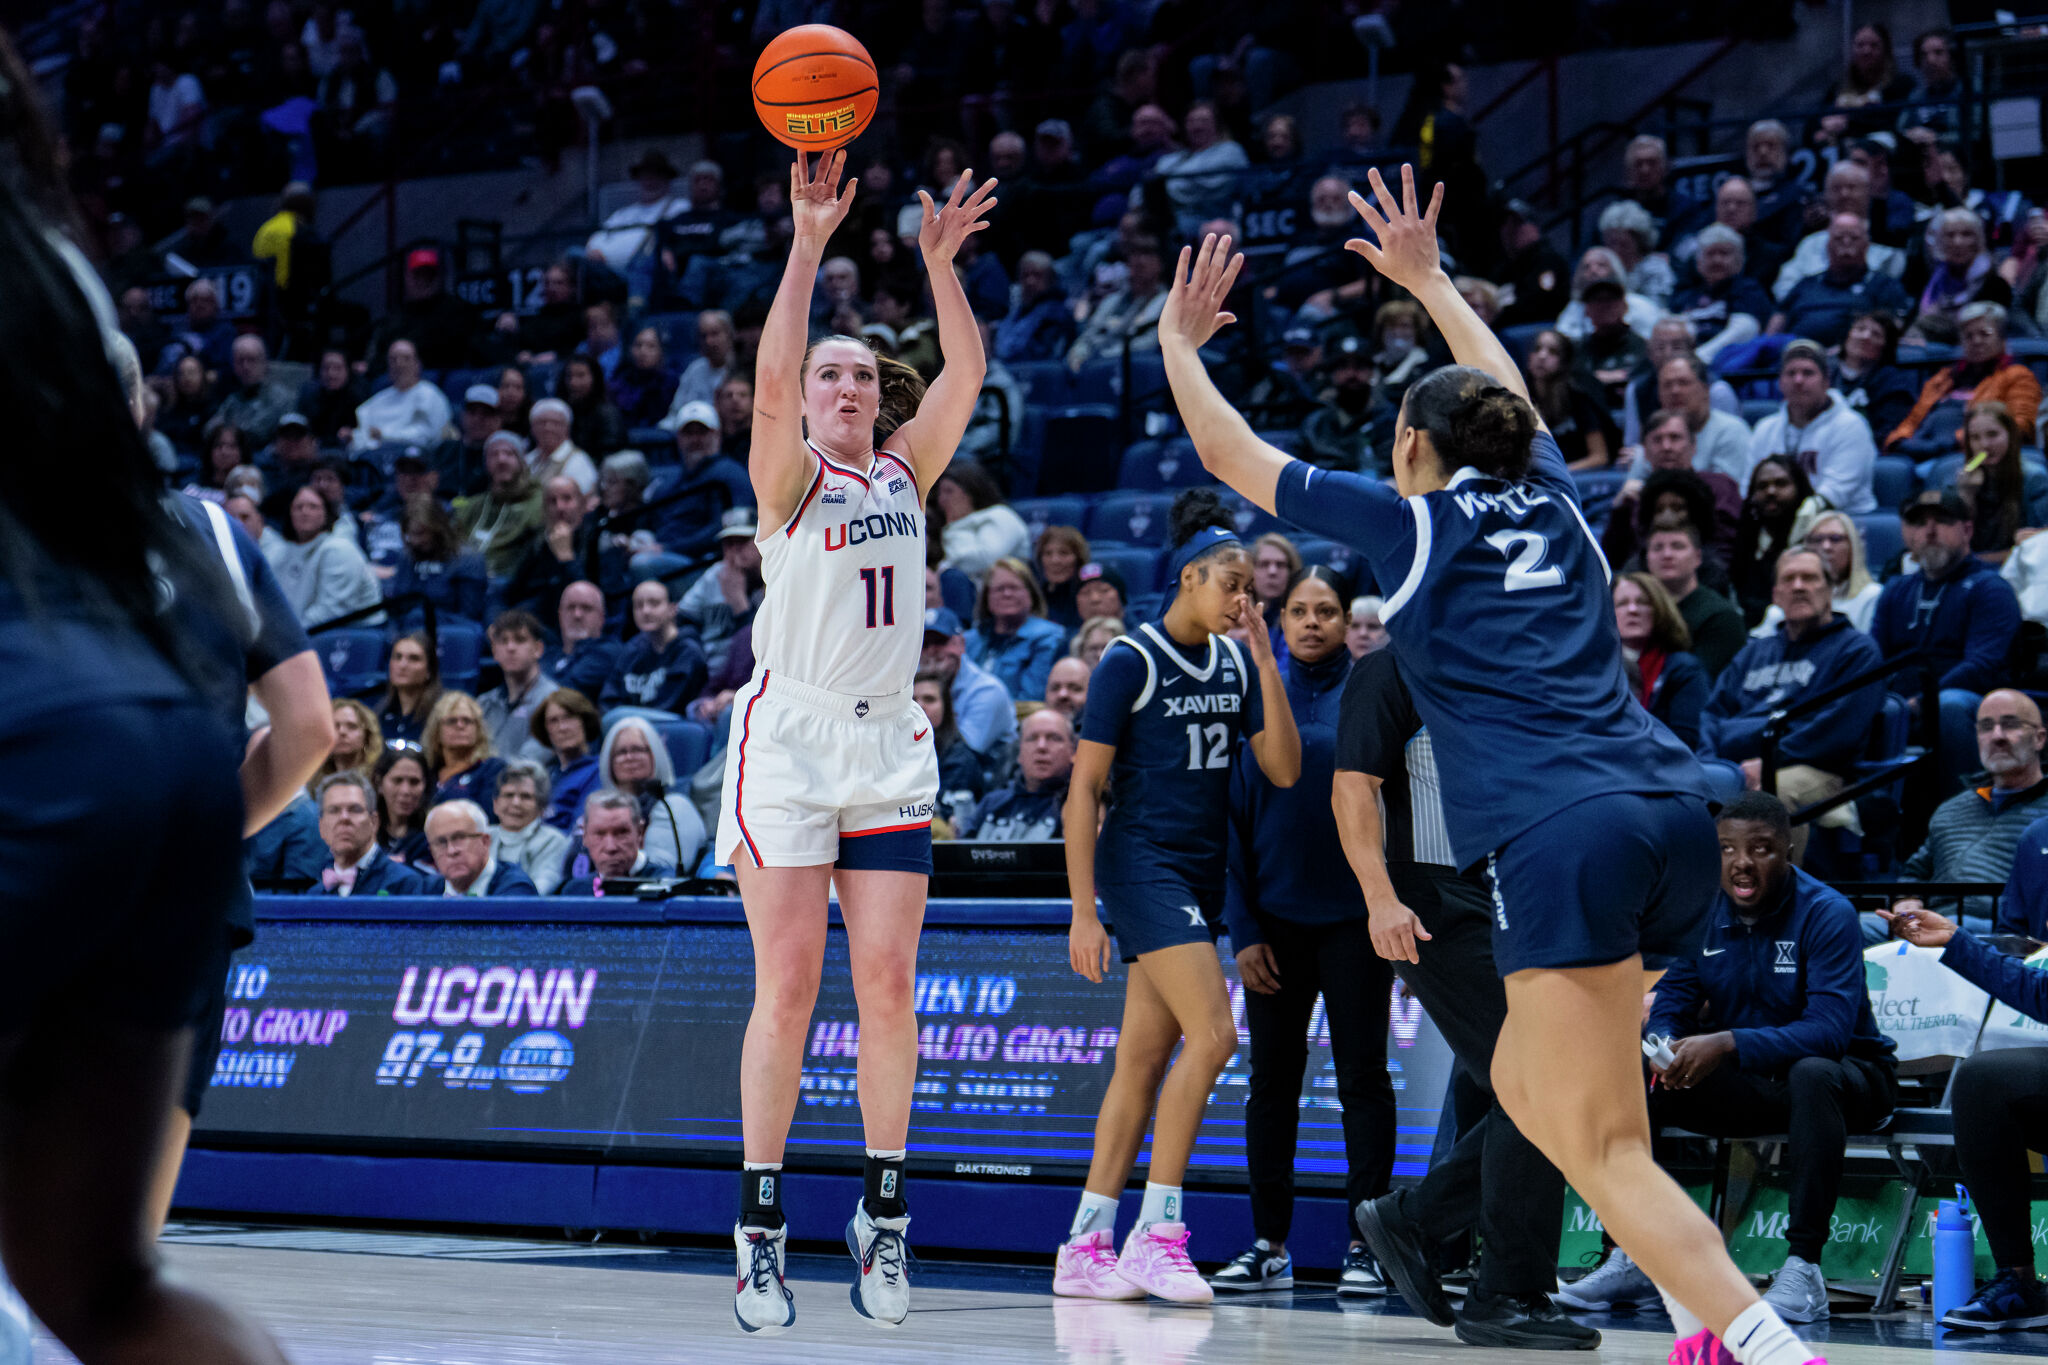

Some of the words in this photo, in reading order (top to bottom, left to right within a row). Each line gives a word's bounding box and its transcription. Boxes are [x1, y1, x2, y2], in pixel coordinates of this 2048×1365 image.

[786, 110, 856, 134] ELITE
[1245, 207, 1296, 238] SEC
[508, 267, 547, 312] 12
[888, 477, 902, 488] BIG
[889, 480, 908, 493] EAST
[825, 512, 918, 551] UCONN
[1484, 528, 1567, 593] 2
[859, 565, 895, 629] 11
[1162, 693, 1241, 718] XAVIER
[1186, 722, 1230, 771] 12
[899, 803, 934, 817] HUSK
[233, 964, 269, 999] TO
[392, 965, 598, 1029] UCONN
[914, 975, 970, 1014] TEN
[974, 975, 1017, 1016] TO
[1871, 992, 1921, 1017] elect
[1911, 1013, 1963, 1031] THERAPY
[220, 1007, 250, 1044] TO
[252, 1008, 348, 1047] GROUP
[1002, 1025, 1120, 1064] GROUP
[210, 1048, 296, 1088] SHOW
[955, 1163, 1033, 1176] DAKTRONICS
[1746, 1210, 1790, 1239] M&
[1828, 1215, 1883, 1244] Bank
